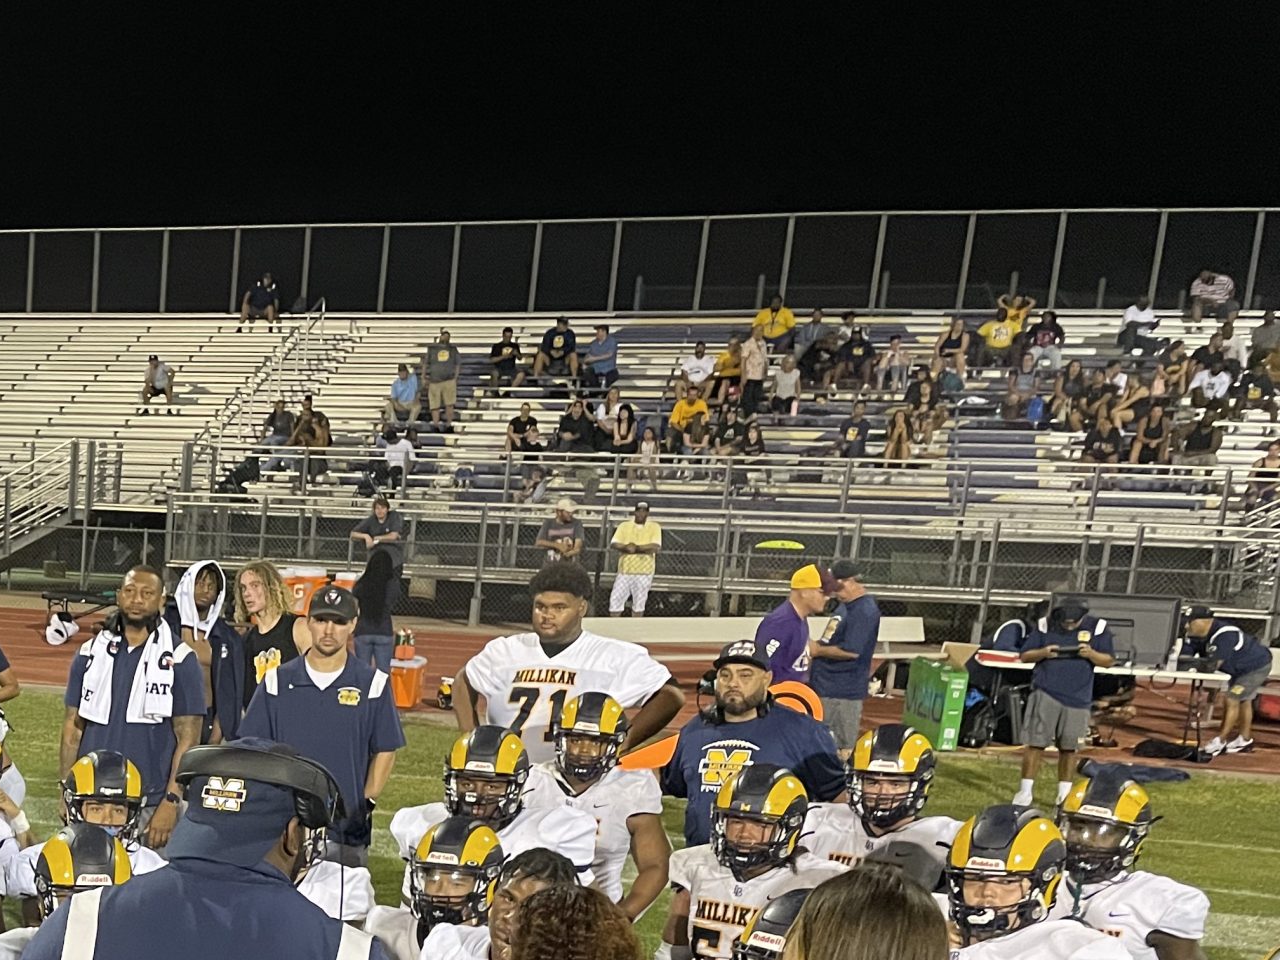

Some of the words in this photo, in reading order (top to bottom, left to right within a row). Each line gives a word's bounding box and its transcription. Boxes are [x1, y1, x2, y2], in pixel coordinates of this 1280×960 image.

[512, 669, 577, 686] MILLIKAN
[508, 687, 568, 742] 71
[752, 933, 782, 946] Riddell
